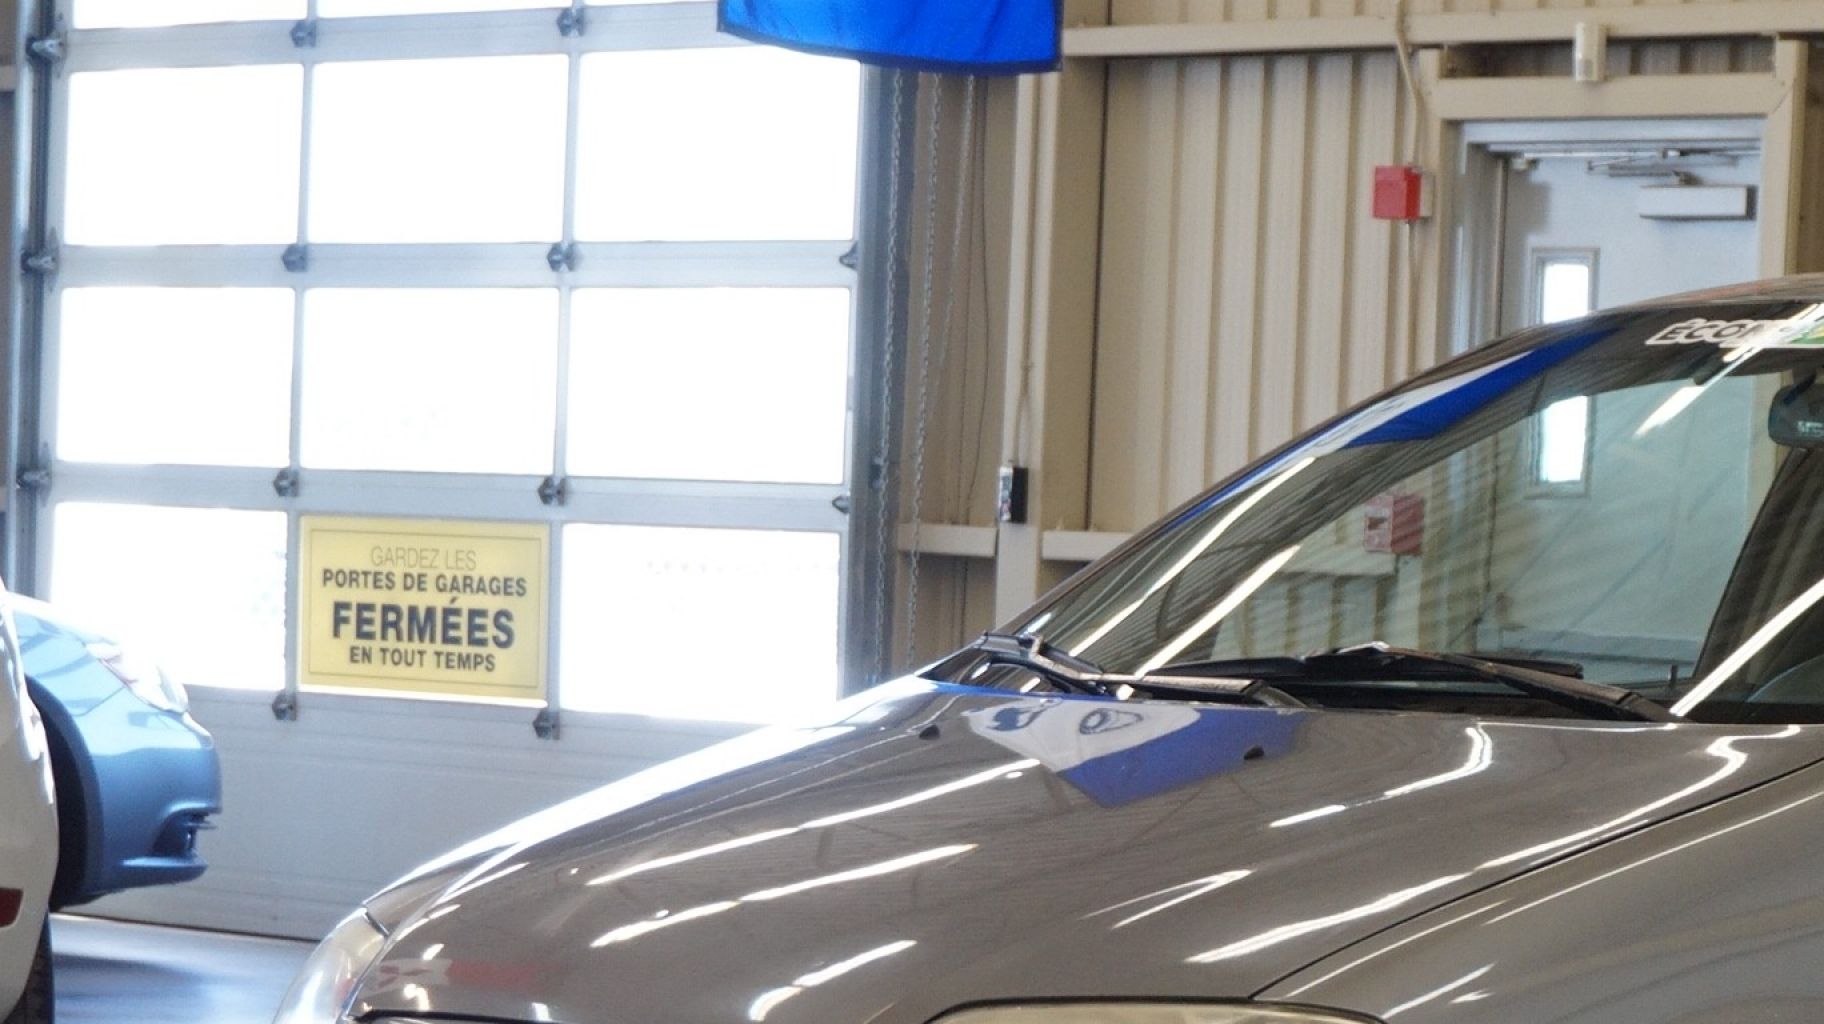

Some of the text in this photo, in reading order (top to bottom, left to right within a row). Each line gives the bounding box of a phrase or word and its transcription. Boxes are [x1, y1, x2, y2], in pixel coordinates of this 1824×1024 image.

[371, 546, 477, 571] GARDEZ LES
[323, 569, 527, 597] PORTES DE GARAGES
[332, 597, 515, 649] FERMÉES
[350, 647, 495, 672] EN TOUT TEMPS
